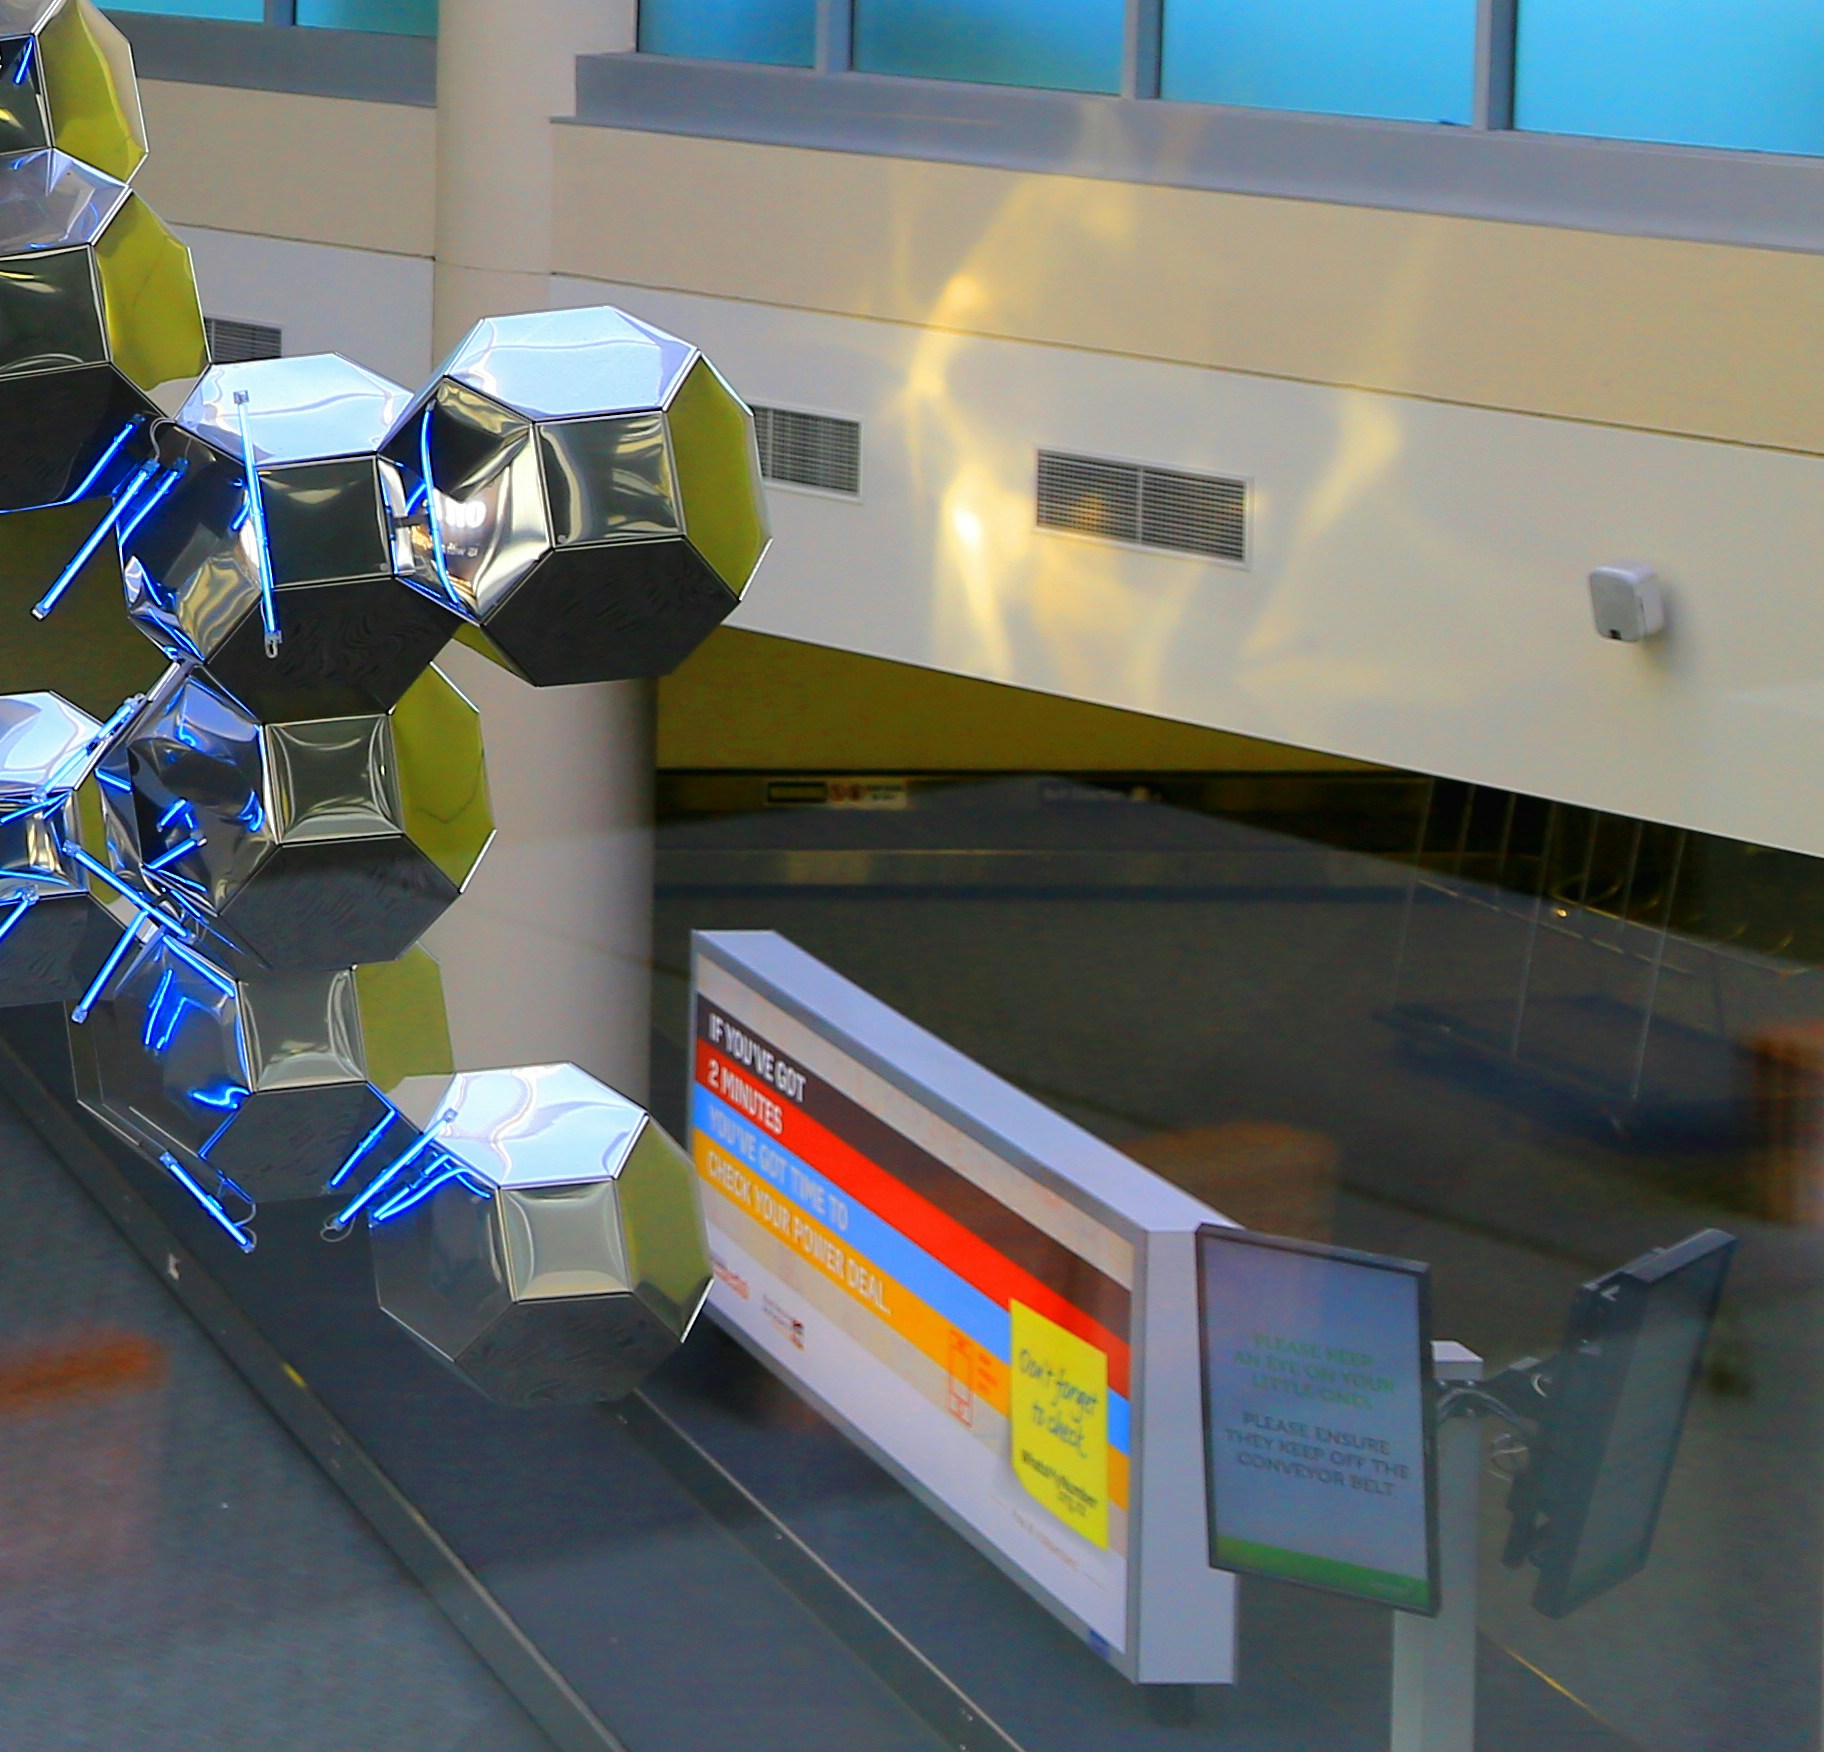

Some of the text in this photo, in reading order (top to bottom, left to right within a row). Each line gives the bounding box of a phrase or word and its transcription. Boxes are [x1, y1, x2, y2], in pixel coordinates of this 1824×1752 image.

[708, 1013, 806, 1103] IF YOU'VE GOT
[707, 1059, 783, 1135] 2 MINUTES
[708, 1103, 849, 1232] YOU'VE GOT TIME TO
[706, 1151, 752, 1207] CHECK
[754, 1184, 791, 1239] YOUR
[794, 1217, 846, 1281] POWER
[847, 1257, 892, 1315] DEAL.
[1253, 1333, 1373, 1368] PLEASE KEEP
[1265, 1355, 1300, 1376] EYE
[1305, 1363, 1335, 1383] ON
[1342, 1369, 1394, 1394] YOUR
[1019, 1347, 1053, 1385] Don't
[1050, 1367, 1099, 1424] forget
[1252, 1374, 1313, 1398] LITTLE
[1032, 1400, 1047, 1428] to
[1242, 1410, 1390, 1456] PLEASE ENSURE
[1224, 1428, 1410, 1480] THEY KEEP OFF THE
[1236, 1450, 1396, 1496] CONVEYOR BELT
